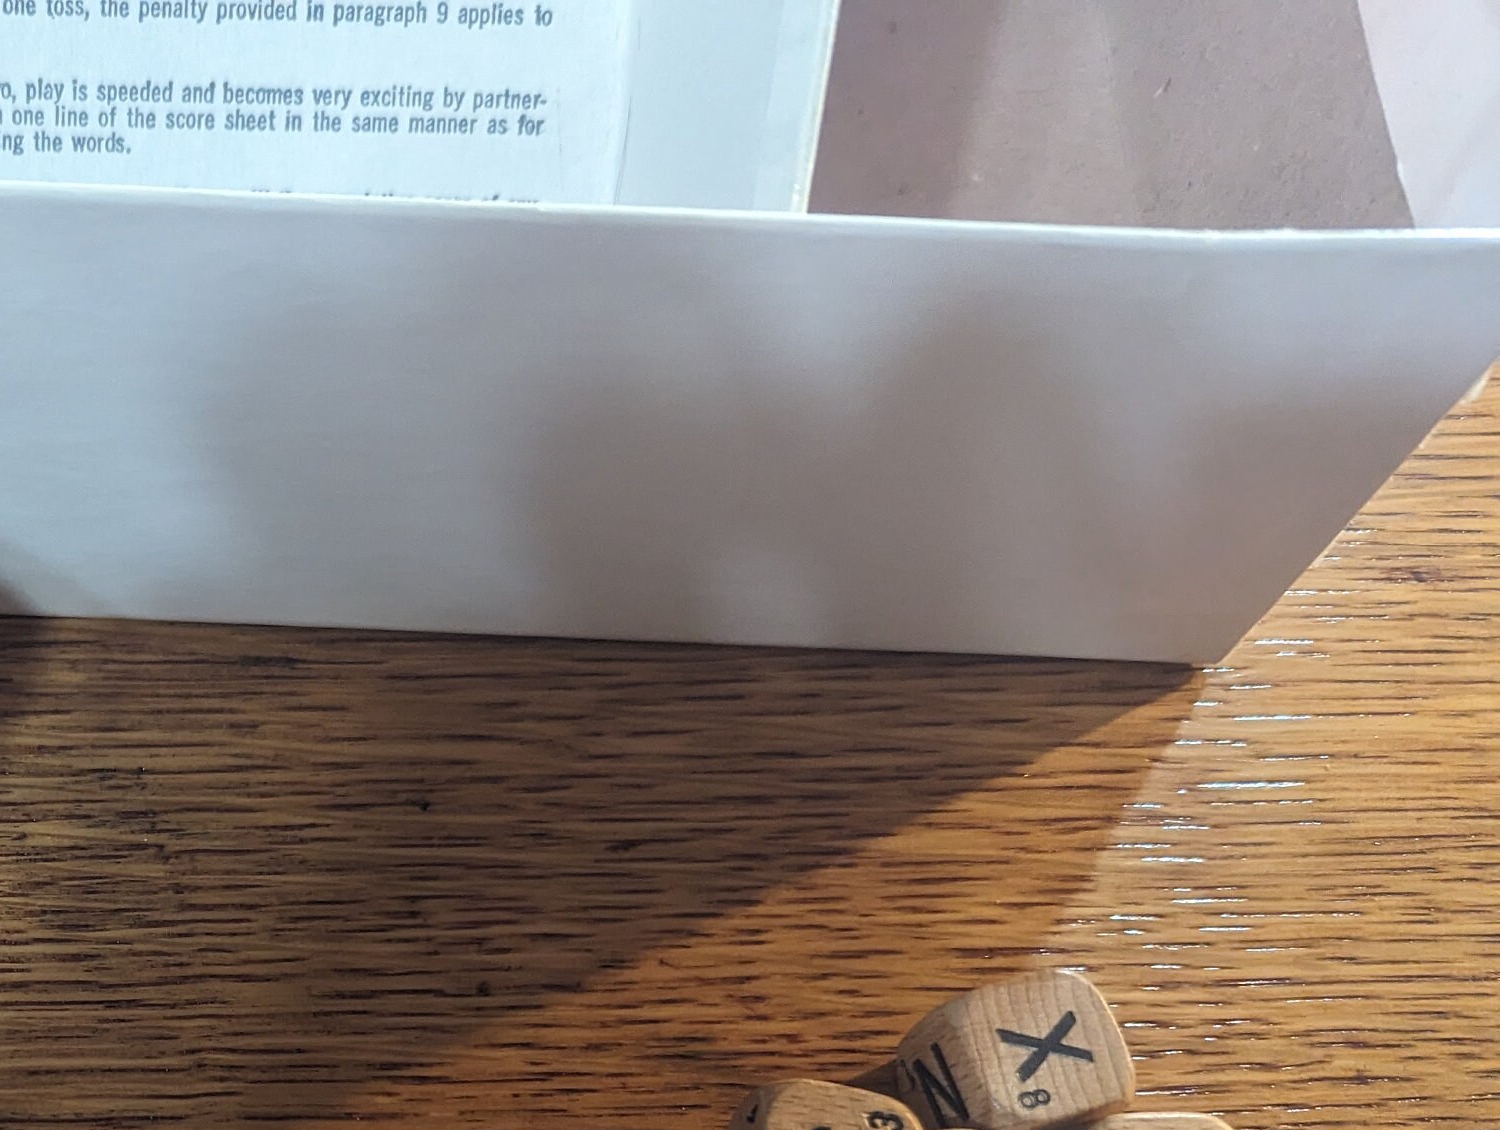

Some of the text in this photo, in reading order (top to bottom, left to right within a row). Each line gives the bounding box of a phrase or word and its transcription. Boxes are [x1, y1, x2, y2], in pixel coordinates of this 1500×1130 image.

[3, 0, 553, 29] one toss, the penalty provided in paragraph 9 applies to
[26, 77, 64, 107] play
[72, 78, 87, 102] is
[97, 80, 173, 106] speeded
[182, 81, 216, 104] and
[223, 81, 303, 105] becomes
[312, 88, 352, 110] very
[360, 85, 434, 112] exciting
[443, 86, 465, 112] by
[473, 88, 547, 113] partner-
[12, 108, 44, 126] one
[55, 102, 88, 127] line
[98, 106, 116, 127] of
[127, 106, 156, 129] the
[166, 111, 215, 130] score
[225, 108, 276, 131] sheet
[285, 110, 302, 132] in
[313, 110, 341, 132] the
[352, 116, 398, 133] same
[409, 117, 478, 134] manner
[487, 118, 508, 135] as
[518, 113, 545, 136] for
[33, 130, 63, 153] the
[71, 131, 131, 154] words.
[995, 1010, 1094, 1082] X
